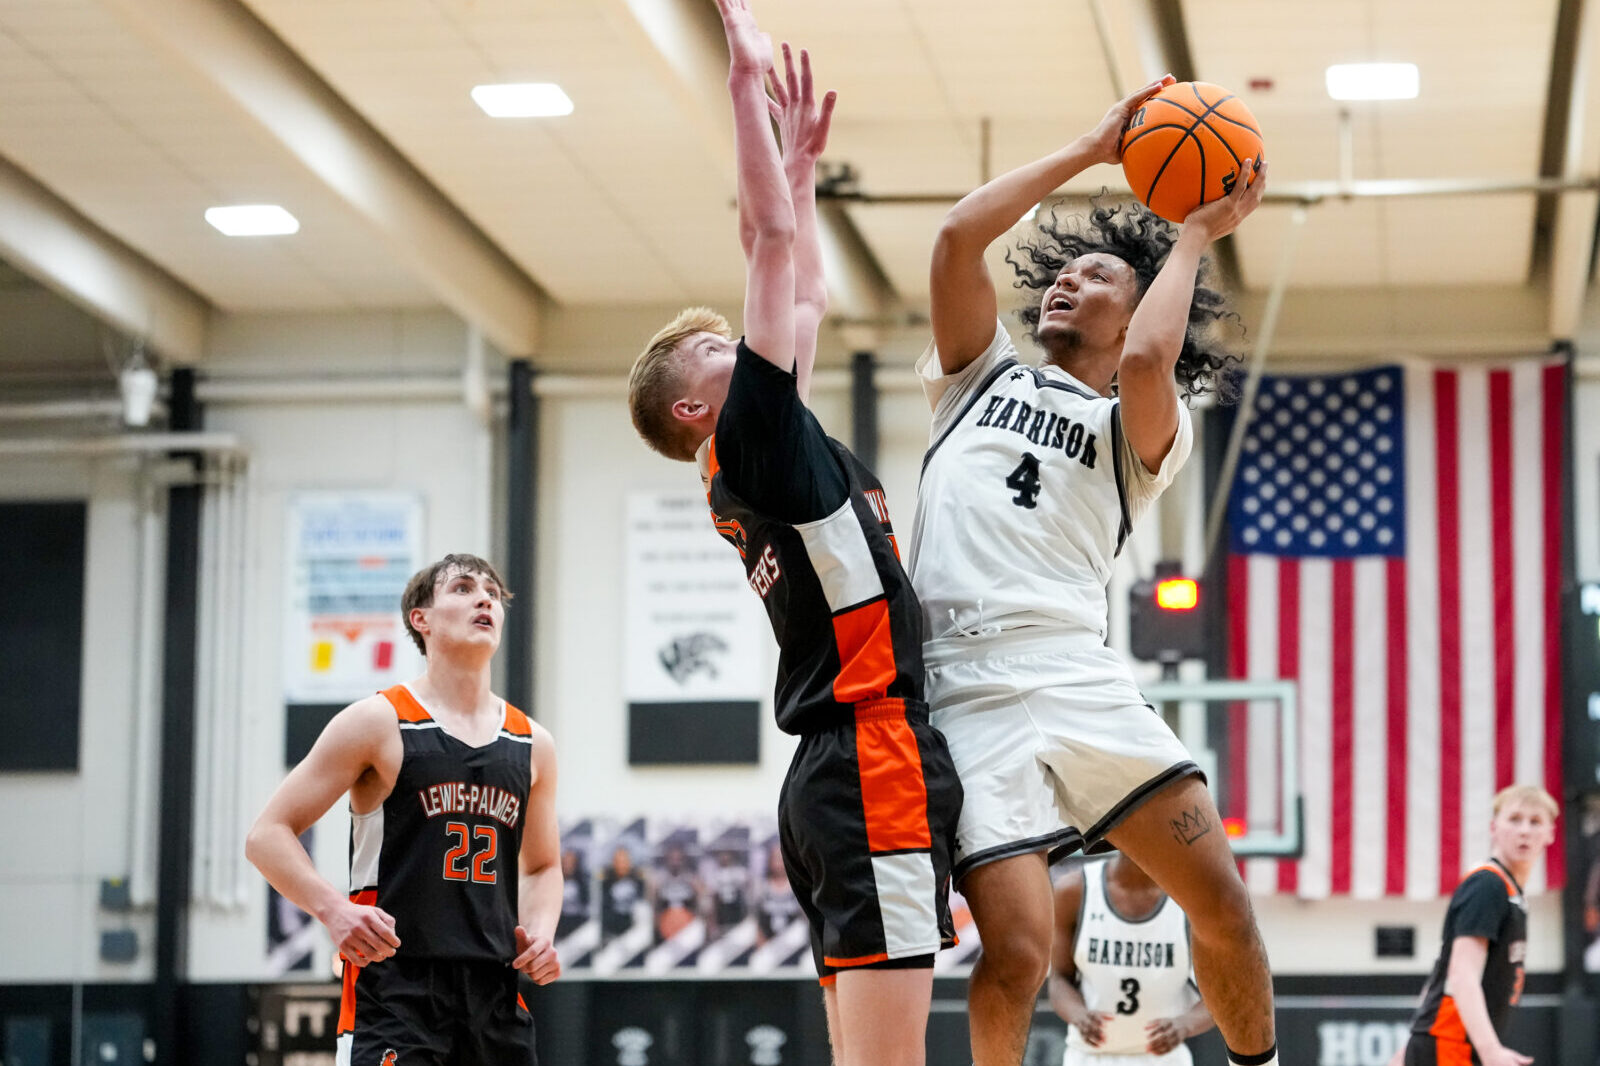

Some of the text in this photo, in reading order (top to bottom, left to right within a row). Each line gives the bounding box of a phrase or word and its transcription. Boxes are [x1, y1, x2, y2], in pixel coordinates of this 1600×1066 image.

[976, 395, 1097, 469] HARRISON
[1006, 452, 1042, 509] 4
[443, 821, 497, 884] 22
[1087, 937, 1175, 968] HARRISON
[1115, 977, 1140, 1016] 3
